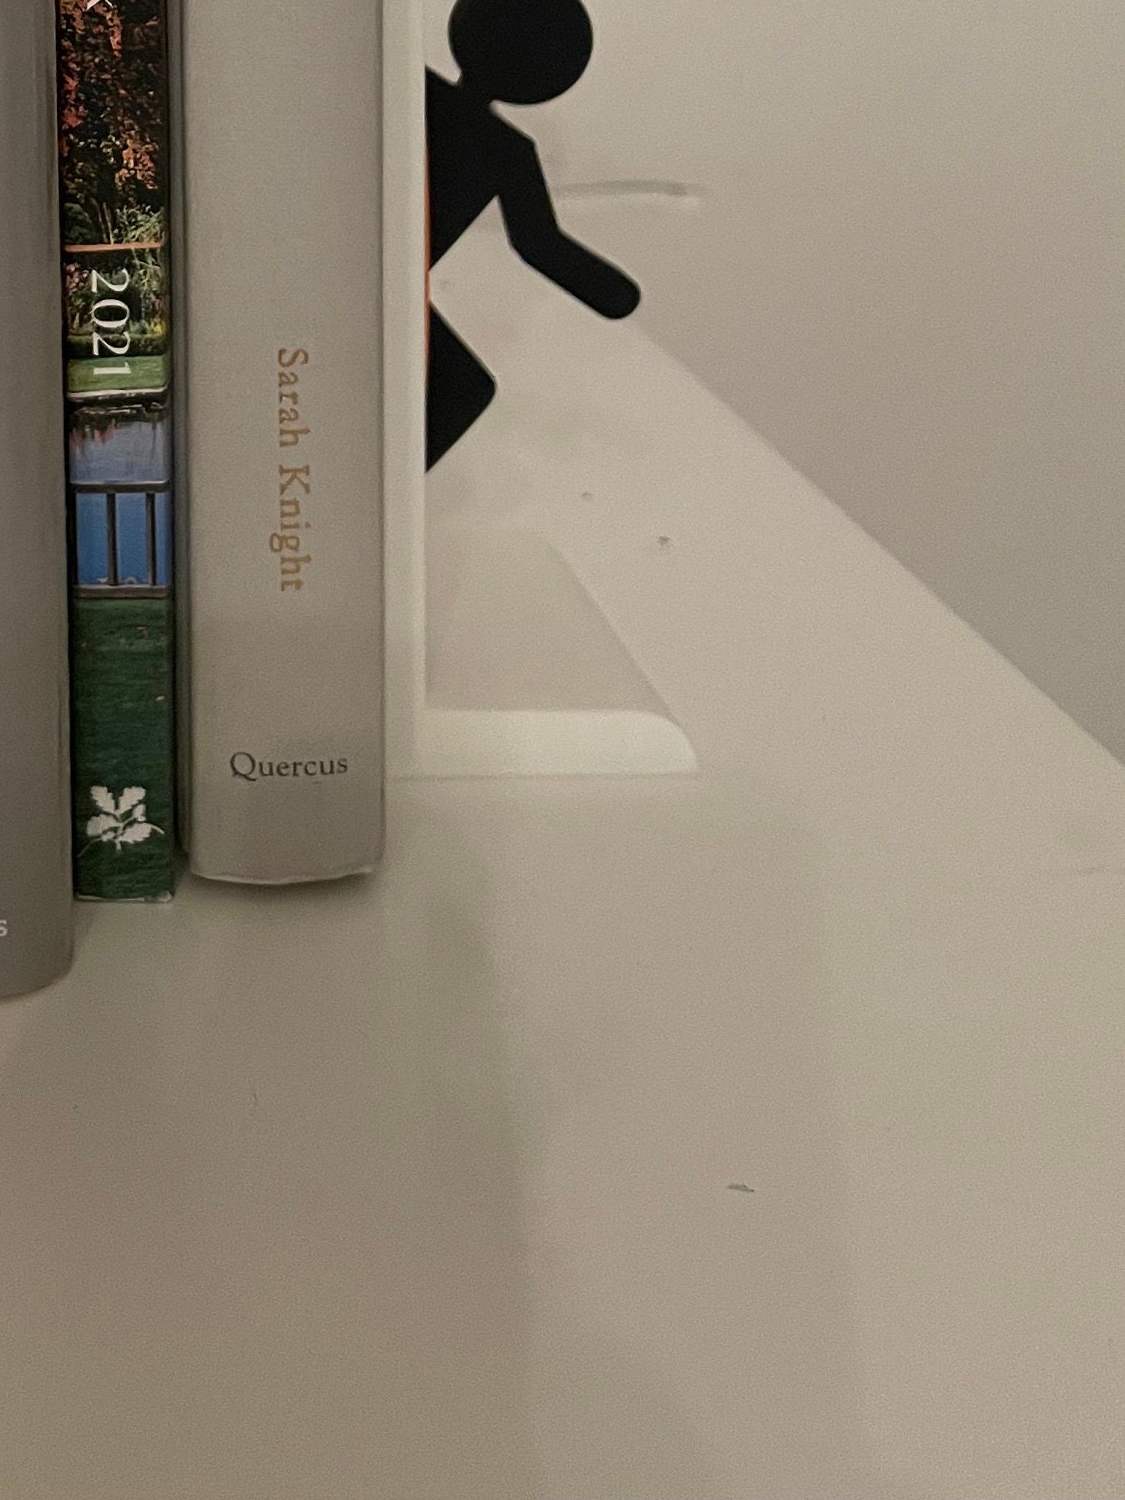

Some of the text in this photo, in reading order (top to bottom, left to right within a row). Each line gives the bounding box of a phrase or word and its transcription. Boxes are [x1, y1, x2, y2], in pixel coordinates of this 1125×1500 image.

[90, 268, 132, 376] 2021
[269, 347, 313, 592] Sarah Knight
[229, 751, 349, 782] Quercus
